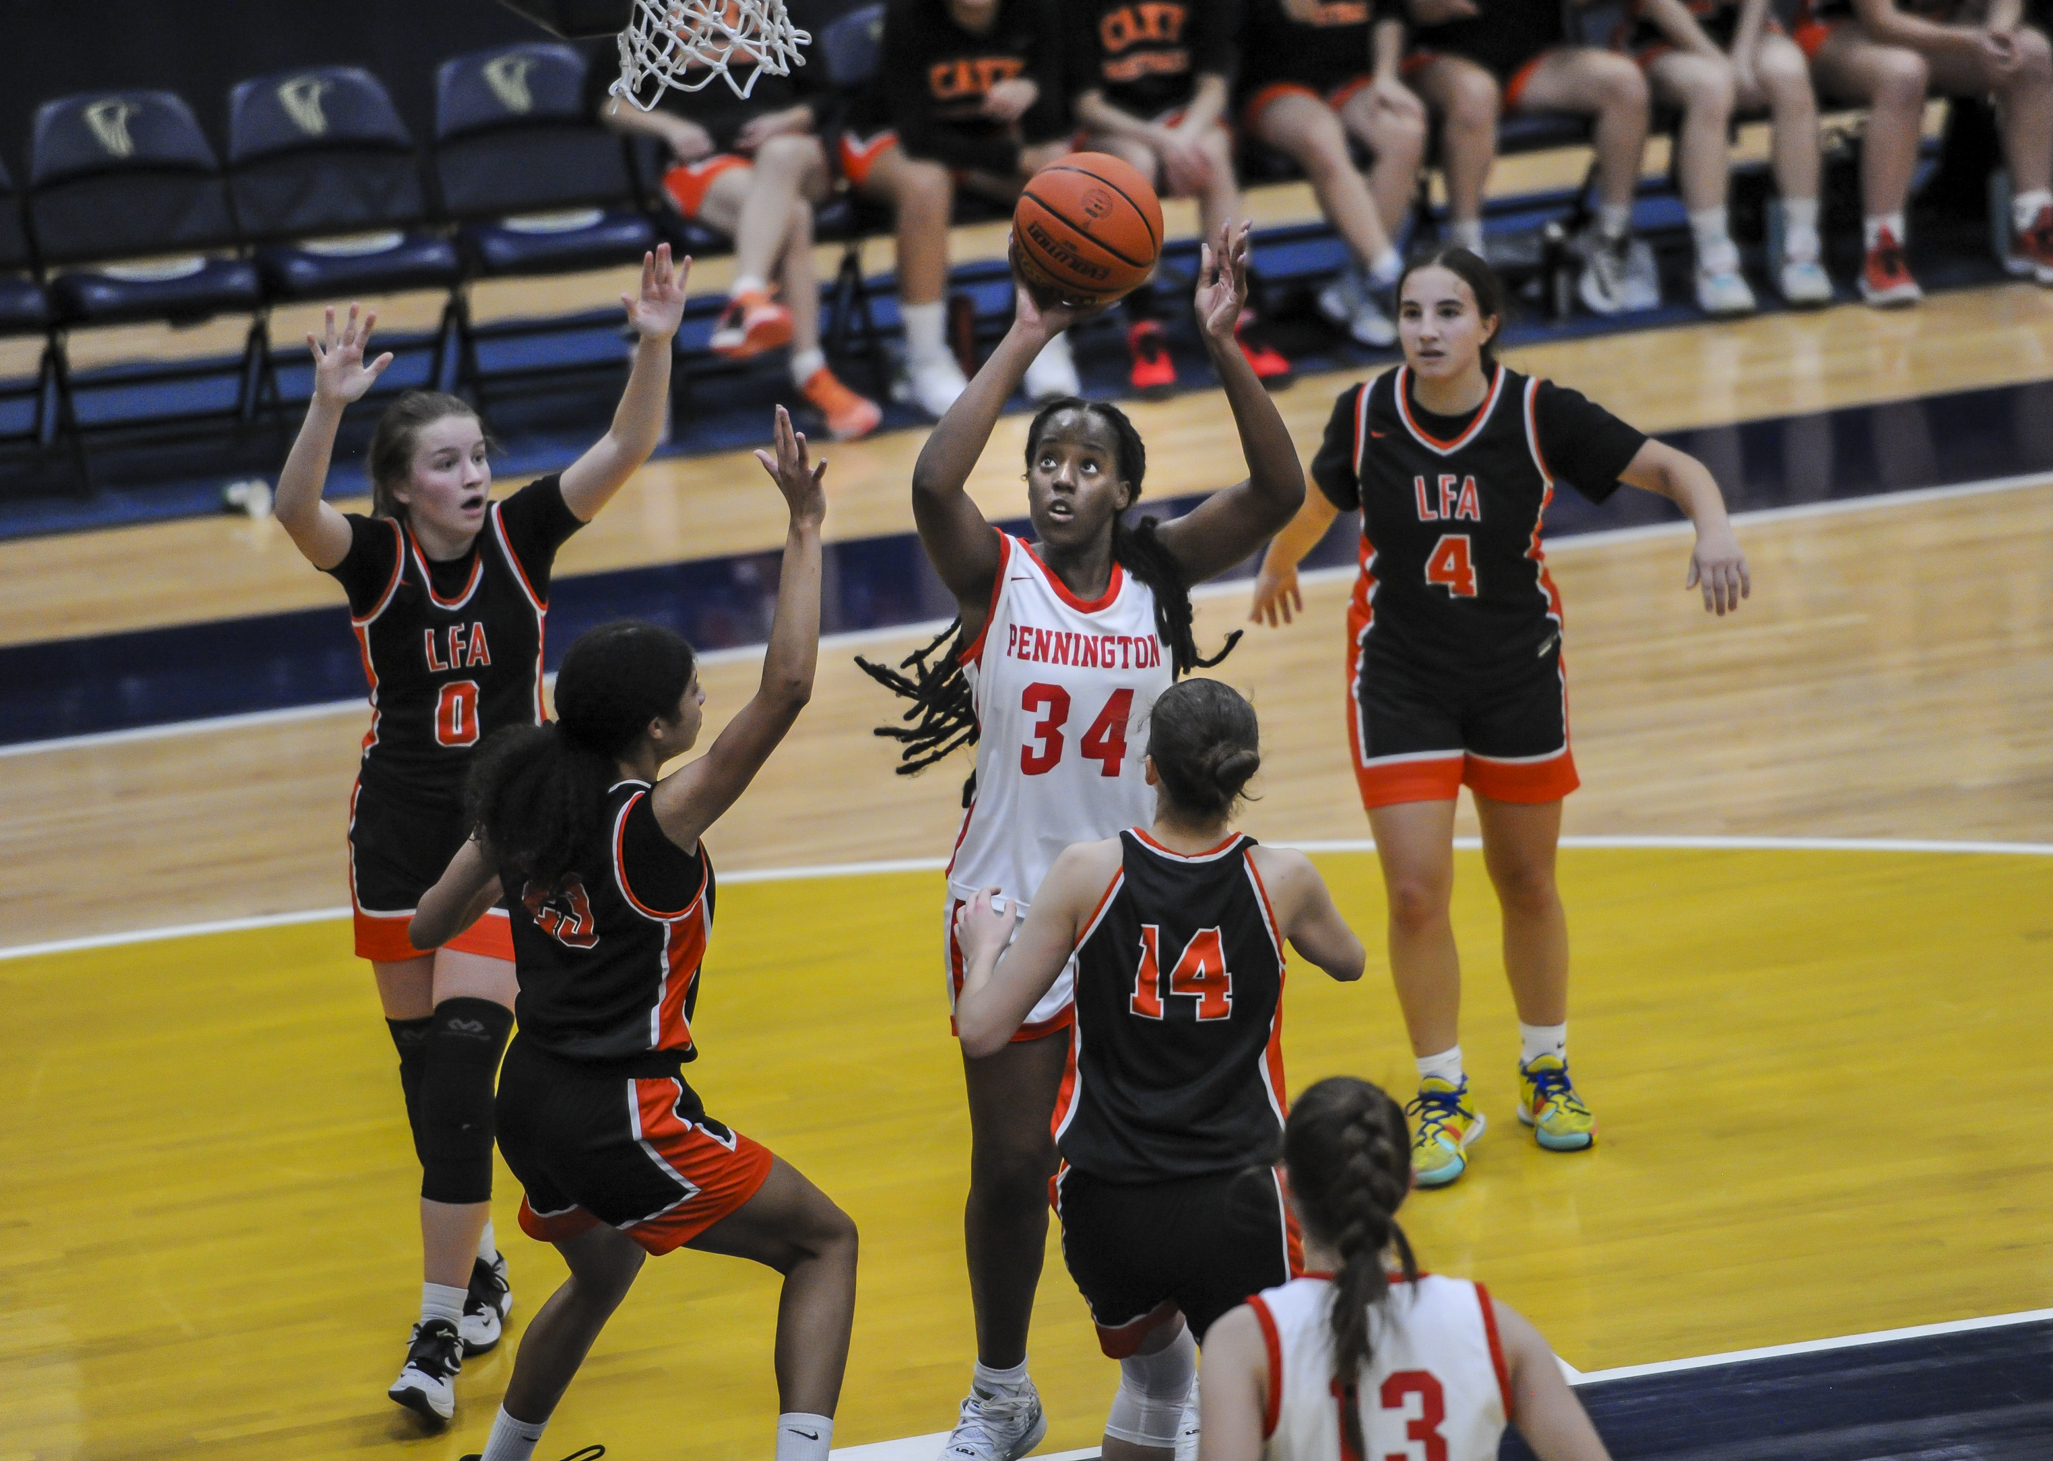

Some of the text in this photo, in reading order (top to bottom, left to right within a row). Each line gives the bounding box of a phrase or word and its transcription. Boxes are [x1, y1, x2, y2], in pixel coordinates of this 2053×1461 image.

[1414, 474, 1481, 522] LFA
[1425, 534, 1478, 598] 4
[425, 622, 491, 673] LFA
[1007, 623, 1161, 669] PENNINGTON
[435, 680, 480, 747] 0
[1020, 682, 1134, 777] 34
[1130, 924, 1232, 1022] 14
